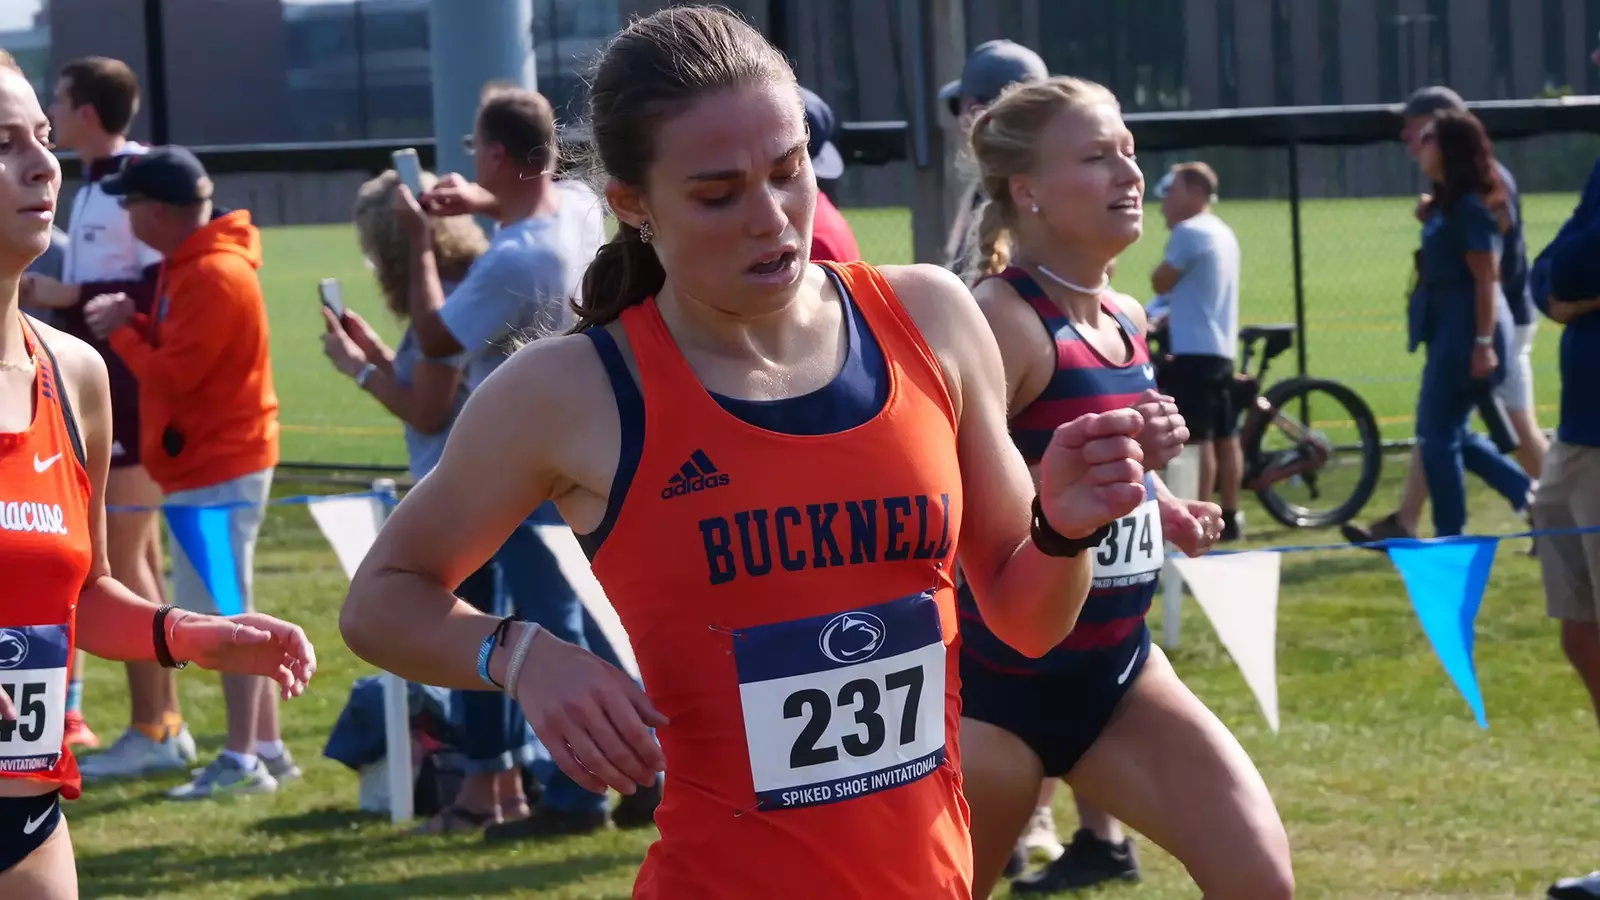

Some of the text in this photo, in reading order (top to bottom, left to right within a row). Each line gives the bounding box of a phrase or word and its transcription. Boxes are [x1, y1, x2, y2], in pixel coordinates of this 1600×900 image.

[661, 473, 731, 500] adidas
[698, 493, 952, 585] BUCKNELL
[1097, 513, 1153, 567] 374
[783, 664, 924, 769] 237
[0, 757, 48, 771] NVITATIONAL
[782, 755, 937, 806] SPIKED SHOE INVITATIONAL
